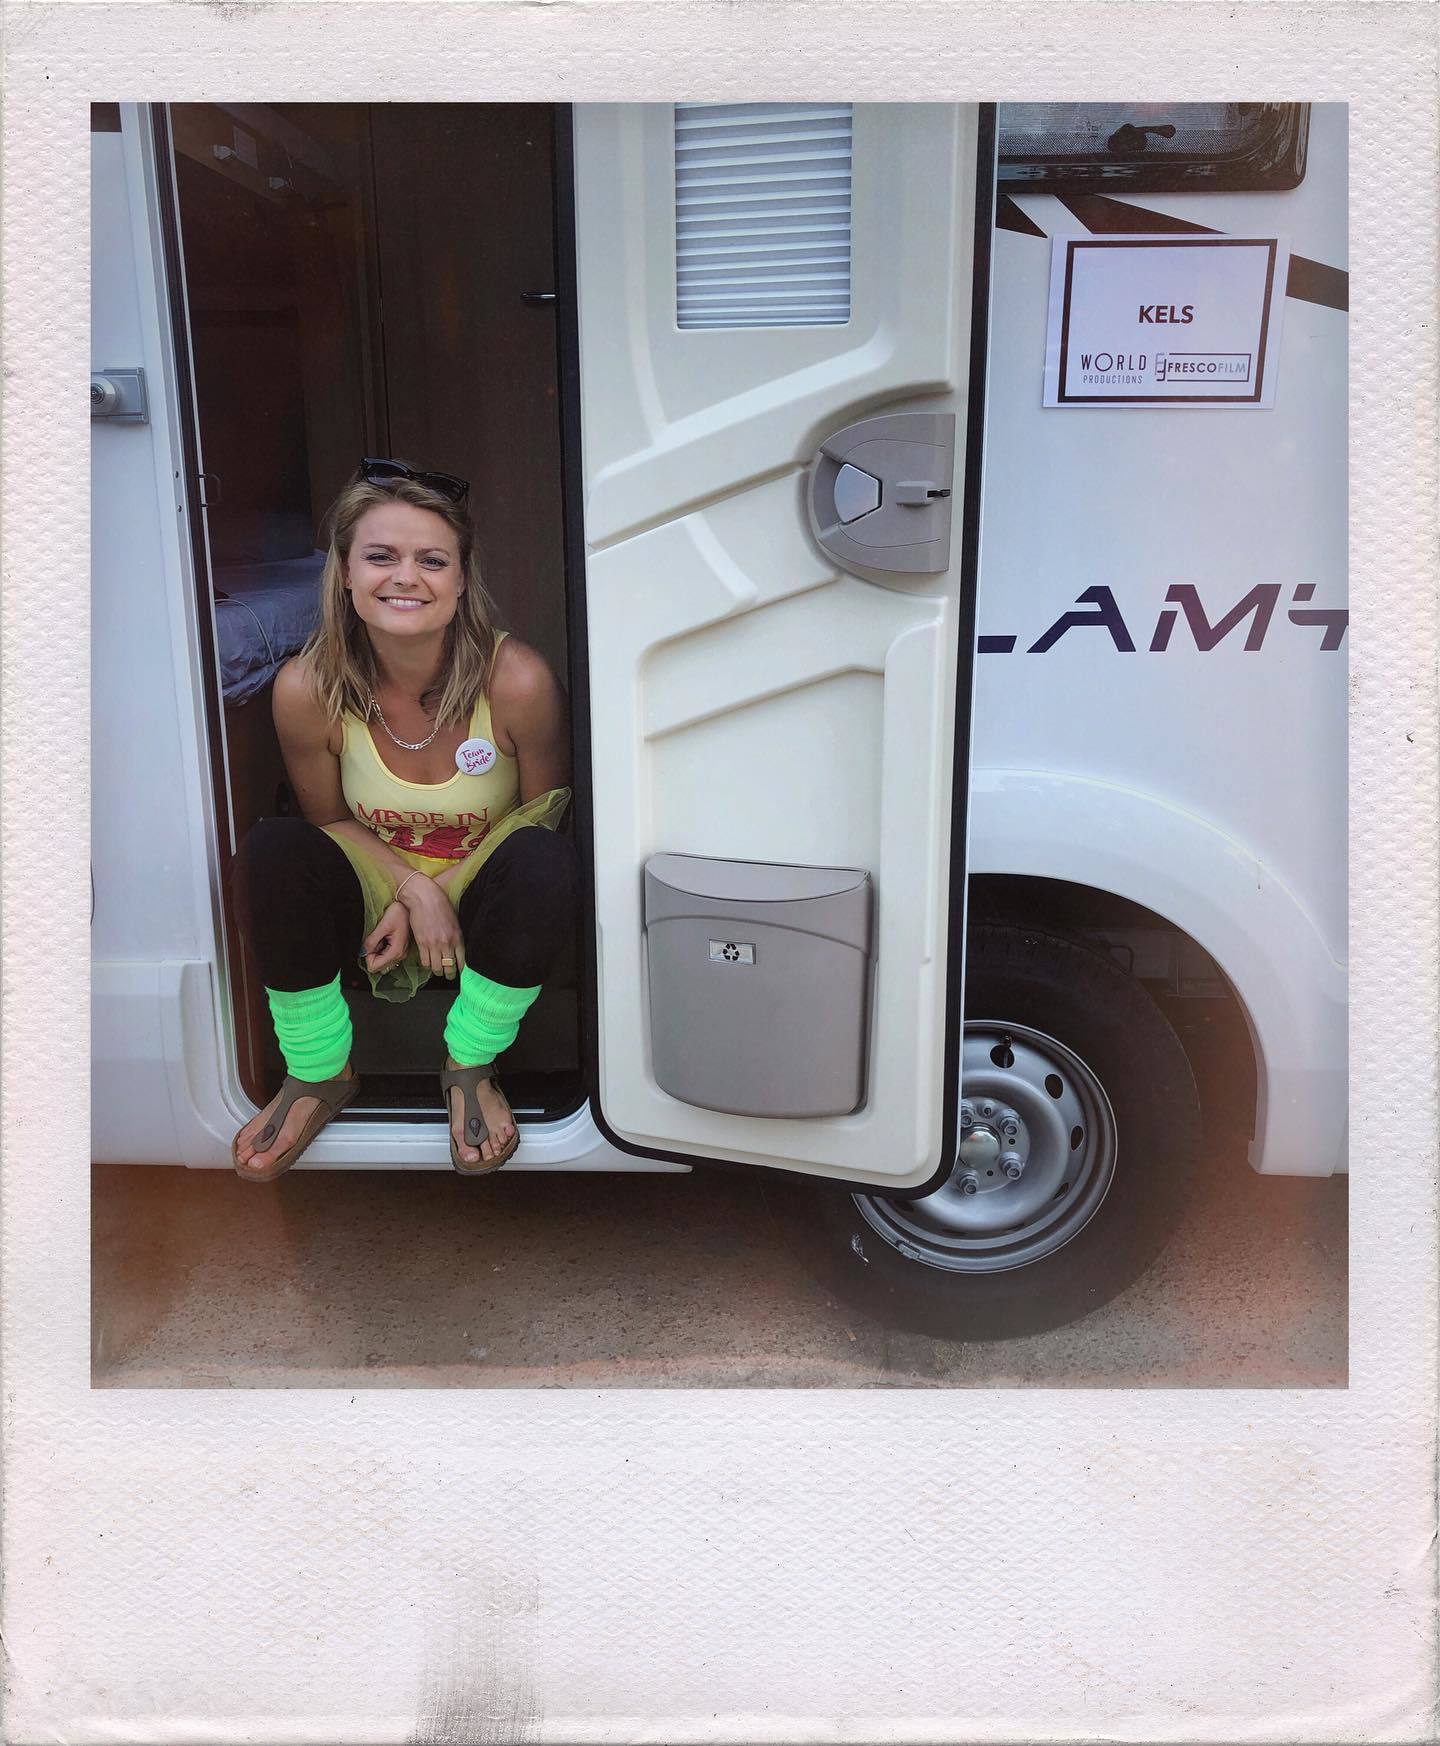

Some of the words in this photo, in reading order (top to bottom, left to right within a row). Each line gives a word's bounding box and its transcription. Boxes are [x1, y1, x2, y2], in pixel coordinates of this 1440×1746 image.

[1138, 304, 1194, 324] KELS
[1080, 352, 1147, 372] WORLD
[1082, 374, 1143, 384] PRODUCTIONS
[460, 748, 485, 761] Team
[356, 800, 445, 825] MADE
[455, 806, 488, 825] IN
